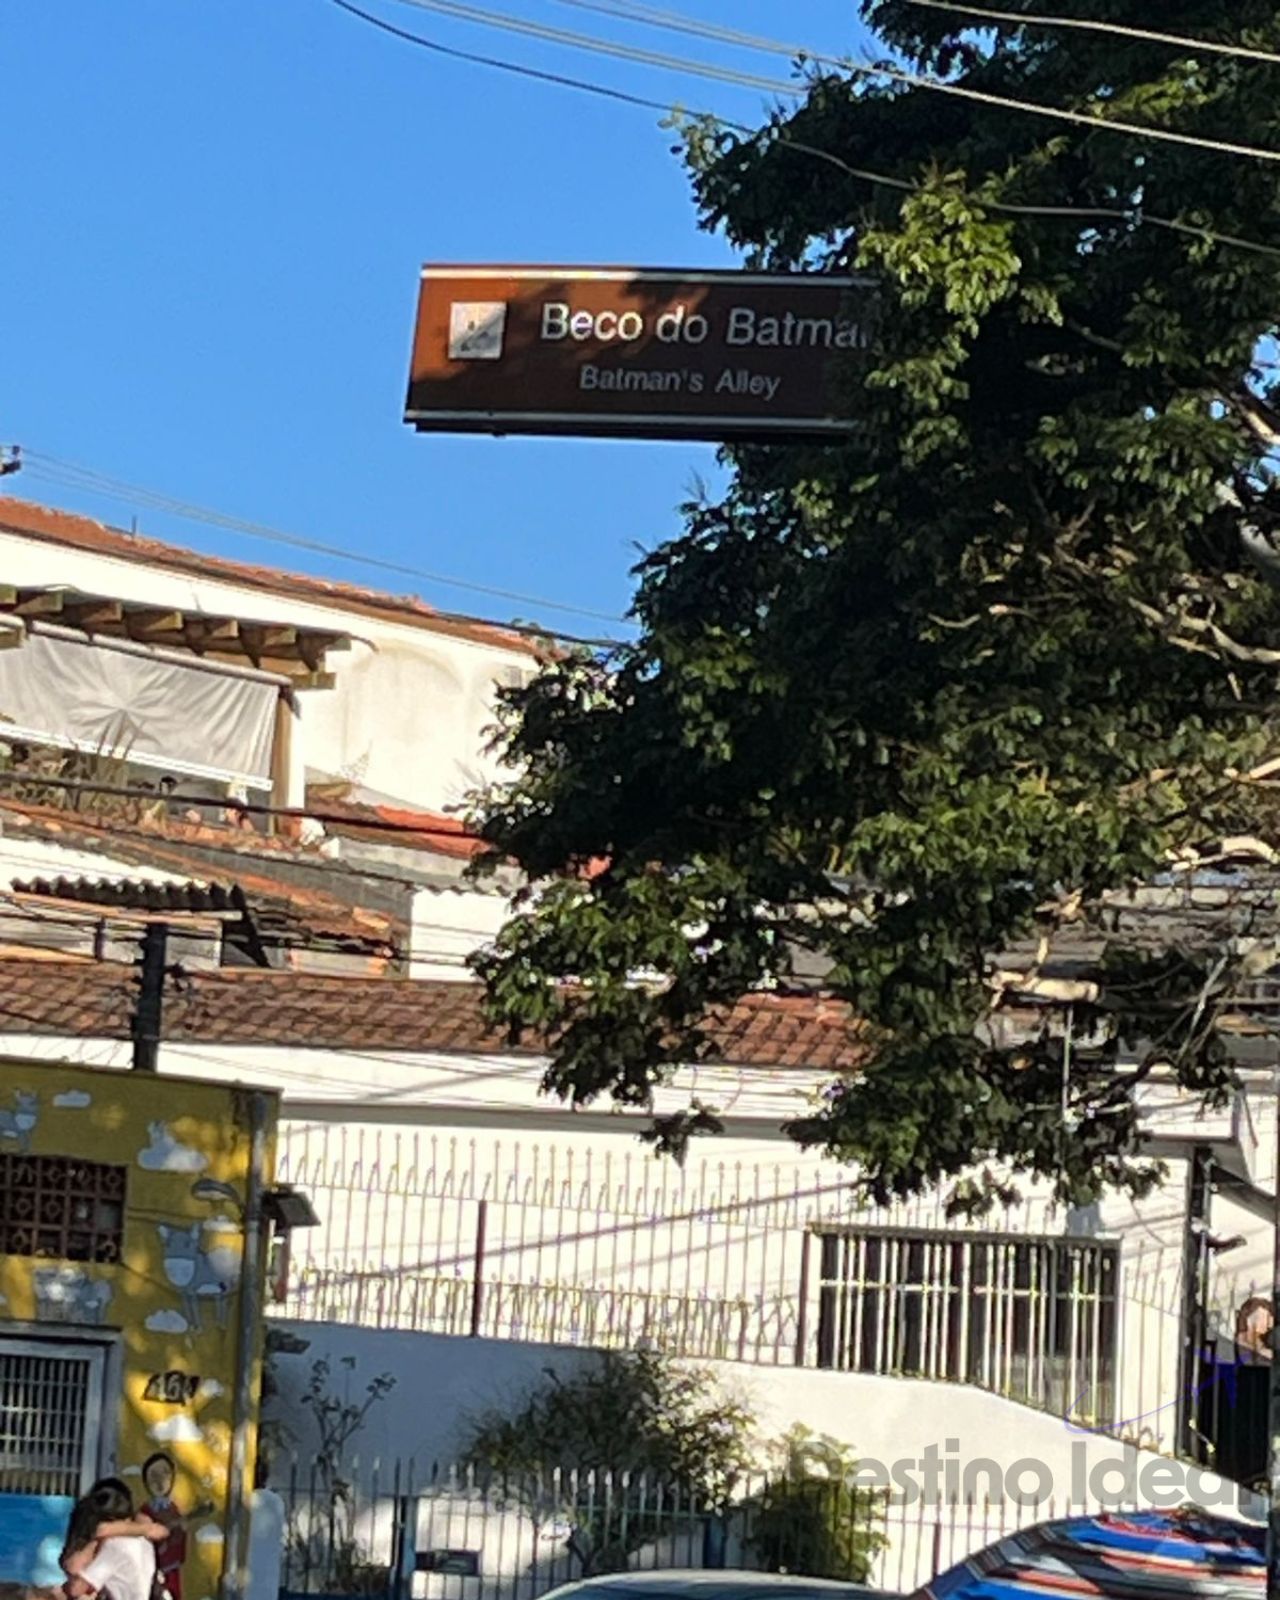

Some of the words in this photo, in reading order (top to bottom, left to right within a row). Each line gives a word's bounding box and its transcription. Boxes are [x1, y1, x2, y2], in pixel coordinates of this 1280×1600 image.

[541, 302, 644, 341] Beco
[655, 304, 709, 345] do
[579, 364, 704, 393] Batman's
[715, 369, 780, 399] Alley
